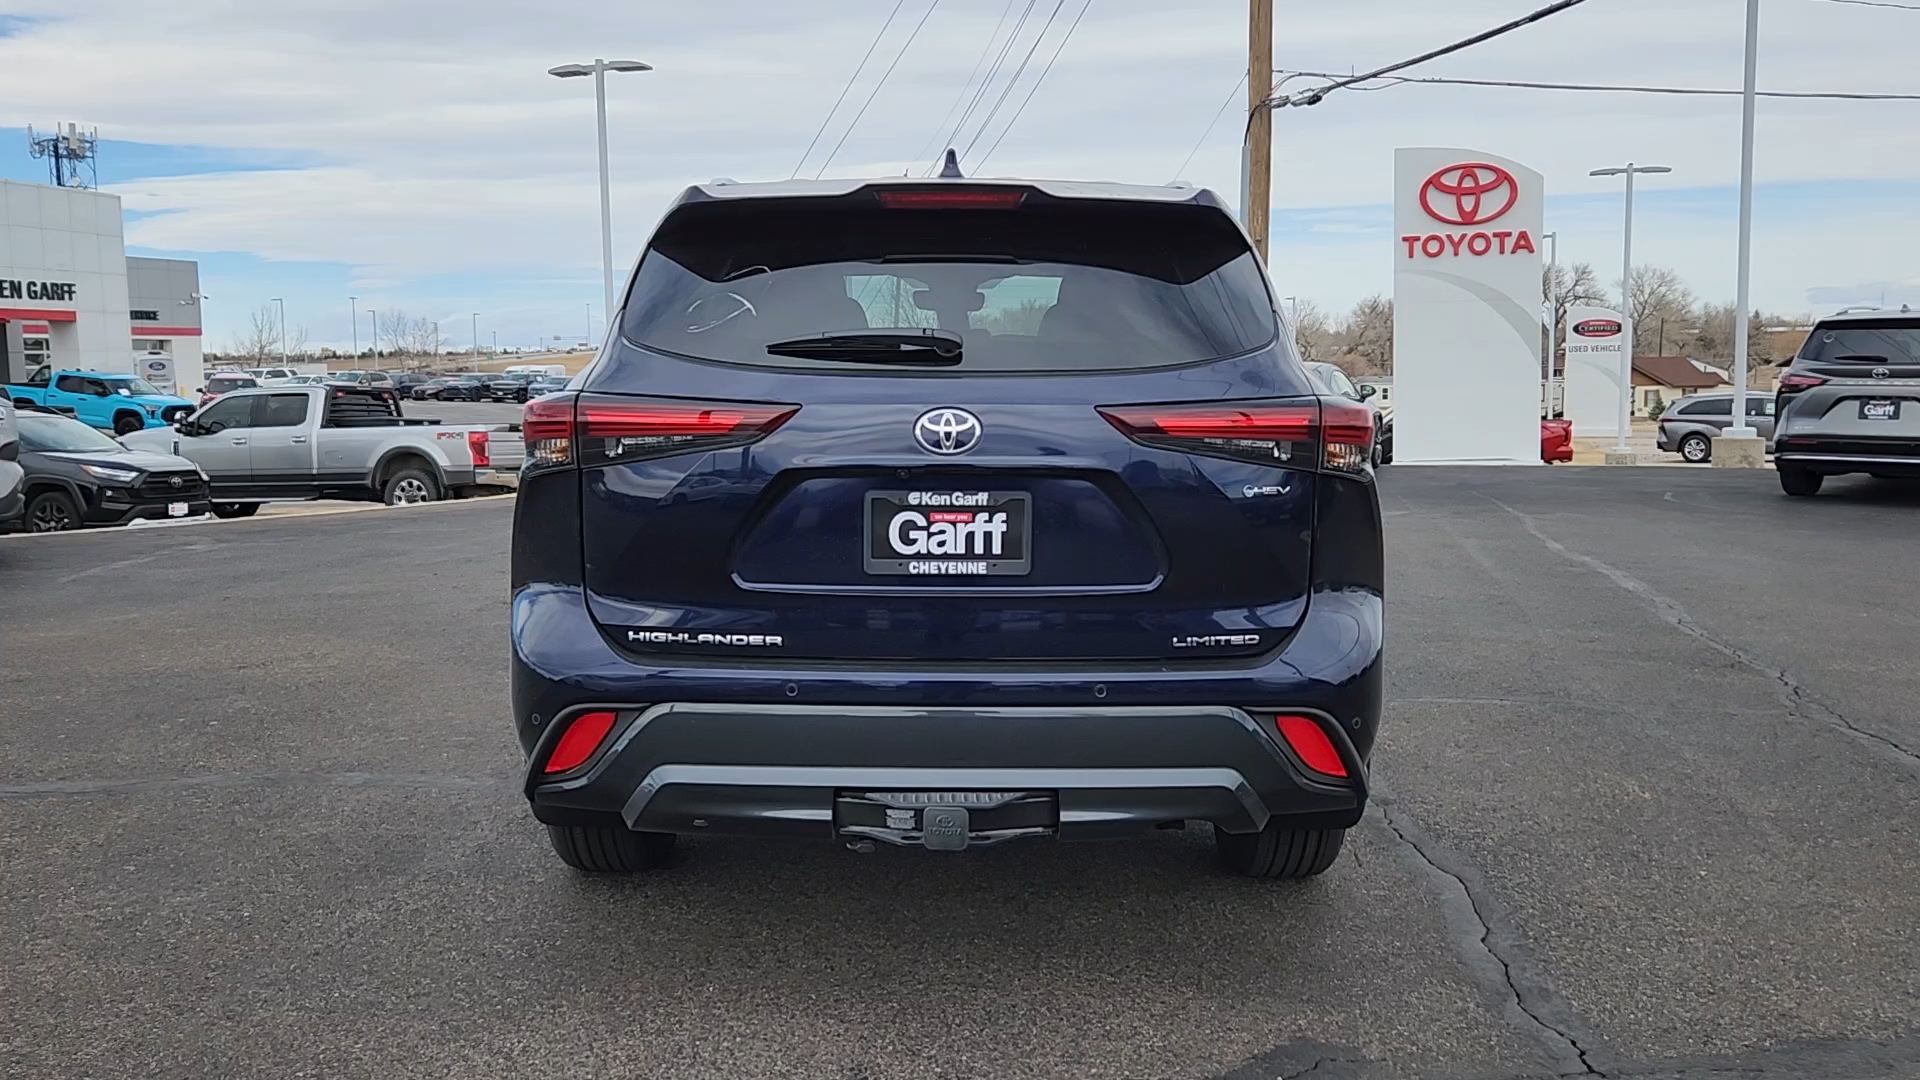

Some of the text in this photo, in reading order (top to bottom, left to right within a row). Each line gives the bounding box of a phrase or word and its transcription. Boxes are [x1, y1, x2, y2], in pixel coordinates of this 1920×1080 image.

[1401, 230, 1536, 259] TOYOTA
[0, 279, 77, 301] EN GARFF
[1568, 344, 1623, 353] USED VEHICLE
[1863, 404, 1895, 416] Garff
[436, 431, 464, 440] FX4
[922, 491, 989, 506] Ken Garff
[944, 513, 957, 521] hear
[888, 511, 1008, 556] Garff
[908, 561, 988, 575] CHEYENNE
[627, 630, 783, 646] HIGHLANDER
[1172, 635, 1260, 647] LIMITED
[927, 826, 963, 836] TOYOTA
